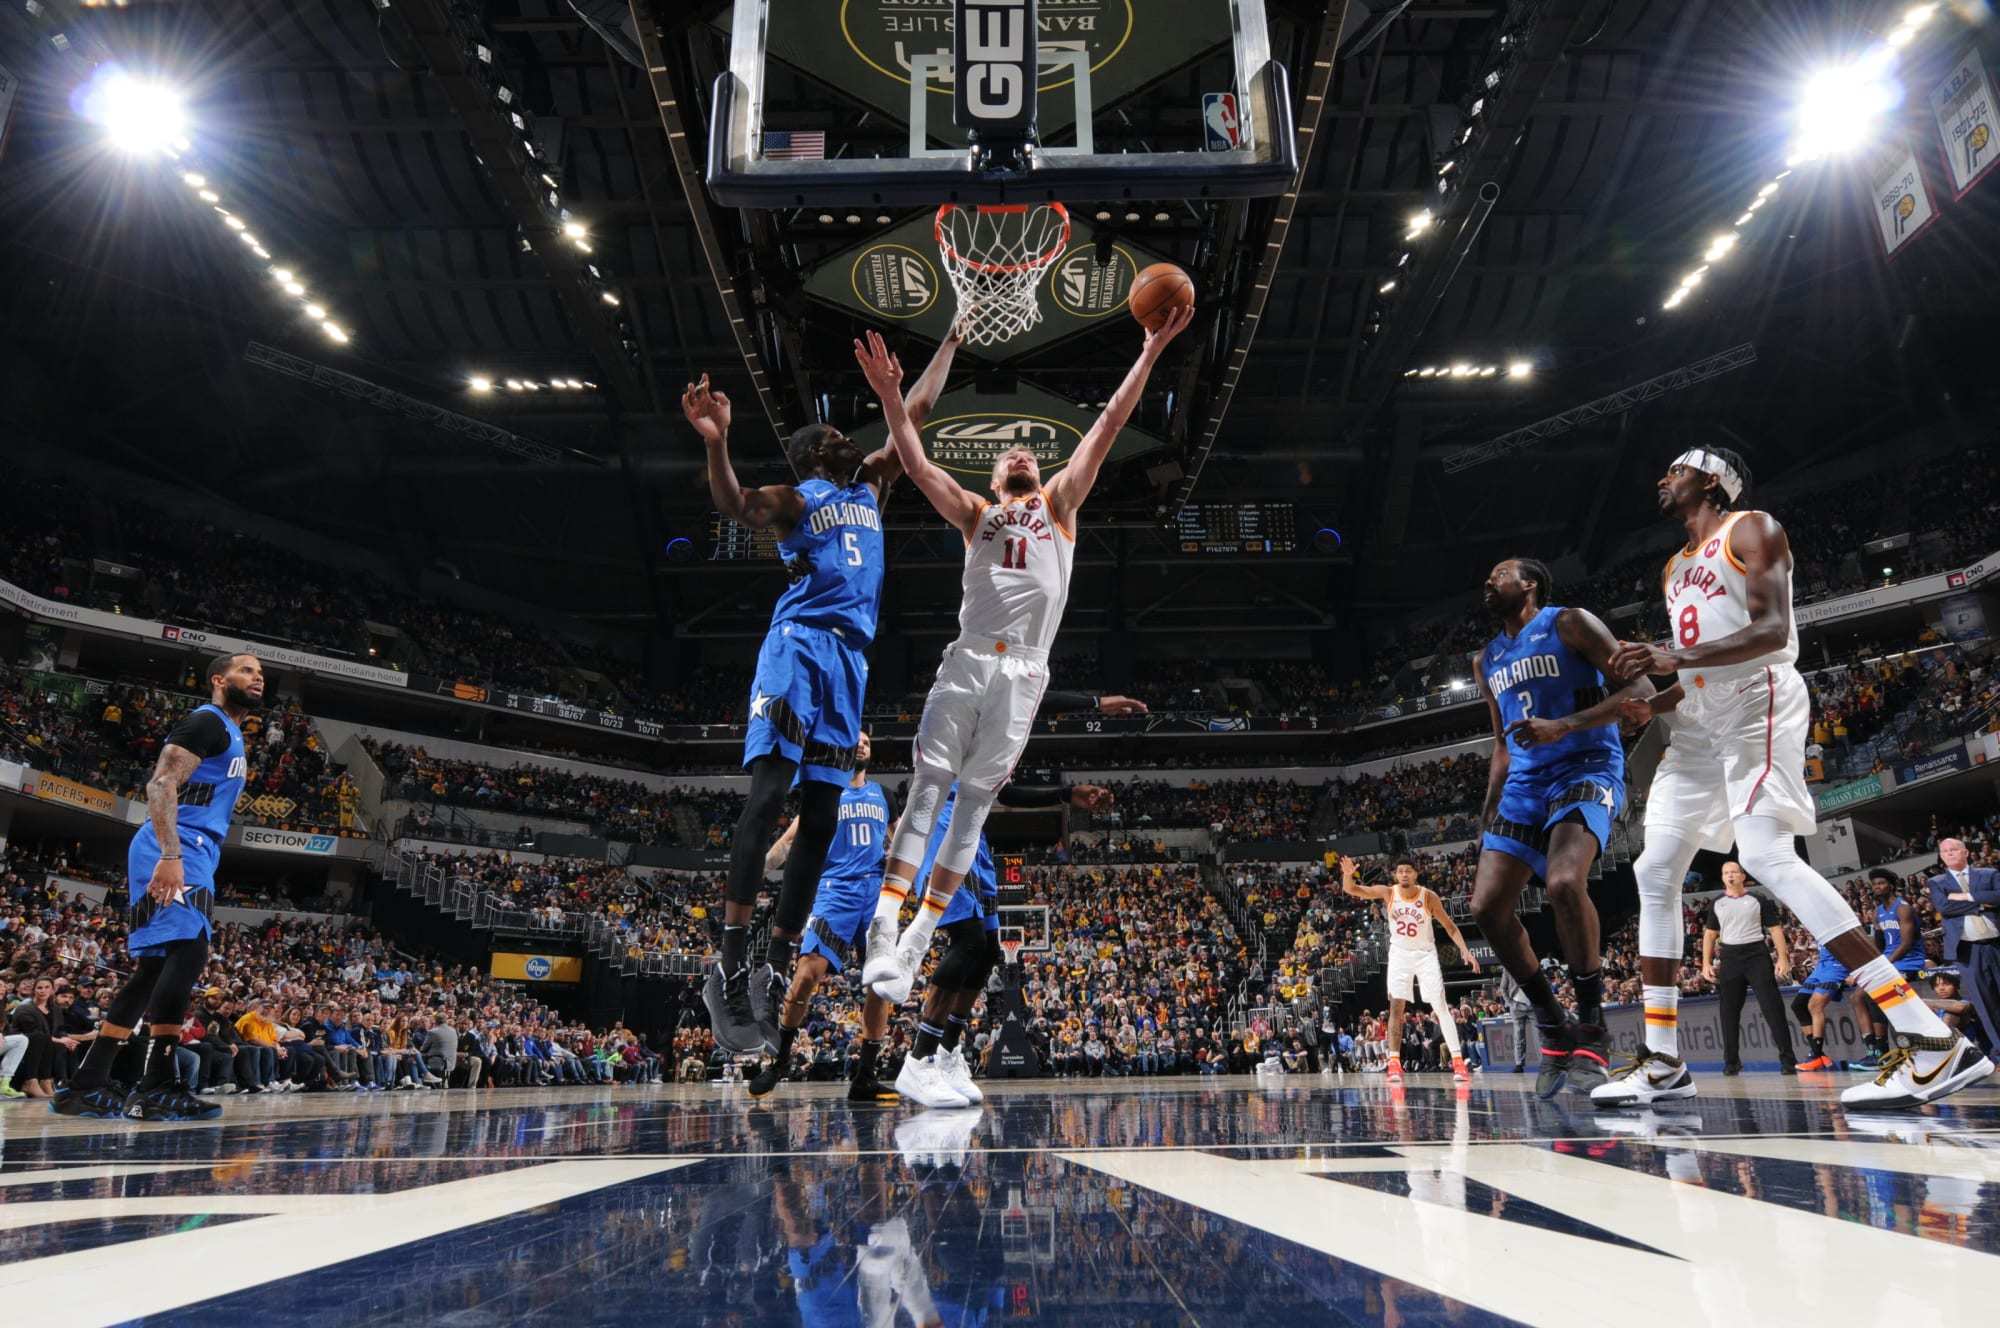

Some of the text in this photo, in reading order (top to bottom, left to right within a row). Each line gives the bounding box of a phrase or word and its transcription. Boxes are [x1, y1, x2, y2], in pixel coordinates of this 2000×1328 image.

[882, 15, 1096, 32] BANS LIFE
[871, 254, 888, 308] FIELDHOUSE
[886, 254, 900, 294] BANKERS
[1087, 270, 1100, 308] BANKERS
[932, 452, 1060, 460] FIELDSE
[809, 502, 880, 535] ORLANDO
[982, 510, 1052, 542] HICKORY
[844, 531, 863, 567] 5
[1002, 537, 1027, 569] 11
[1966, 564, 1984, 579] CNO
[20, 593, 79, 619] Retirement
[1668, 565, 1728, 620] ICKORY
[1815, 596, 1875, 618] Retirement
[181, 631, 206, 642] CNO
[1679, 604, 1700, 648] 8
[246, 643, 276, 658] Proud
[288, 654, 306, 665] call
[307, 658, 341, 672] central
[343, 663, 377, 678] Indiana
[1488, 655, 1560, 700] ORLANDO
[1517, 691, 1536, 720] 2
[1086, 720, 1102, 732] 92
[1914, 753, 1958, 773] Renaissance
[40, 779, 112, 810] PACERS.COM
[1819, 791, 1852, 809] EMBASSY
[1853, 782, 1882, 798] SUITES
[244, 831, 329, 850] SECTION 127
[850, 823, 871, 846] 10
[1005, 866, 1021, 882] 16
[1396, 921, 1417, 937] 26
[527, 960, 549, 977] Kroger
